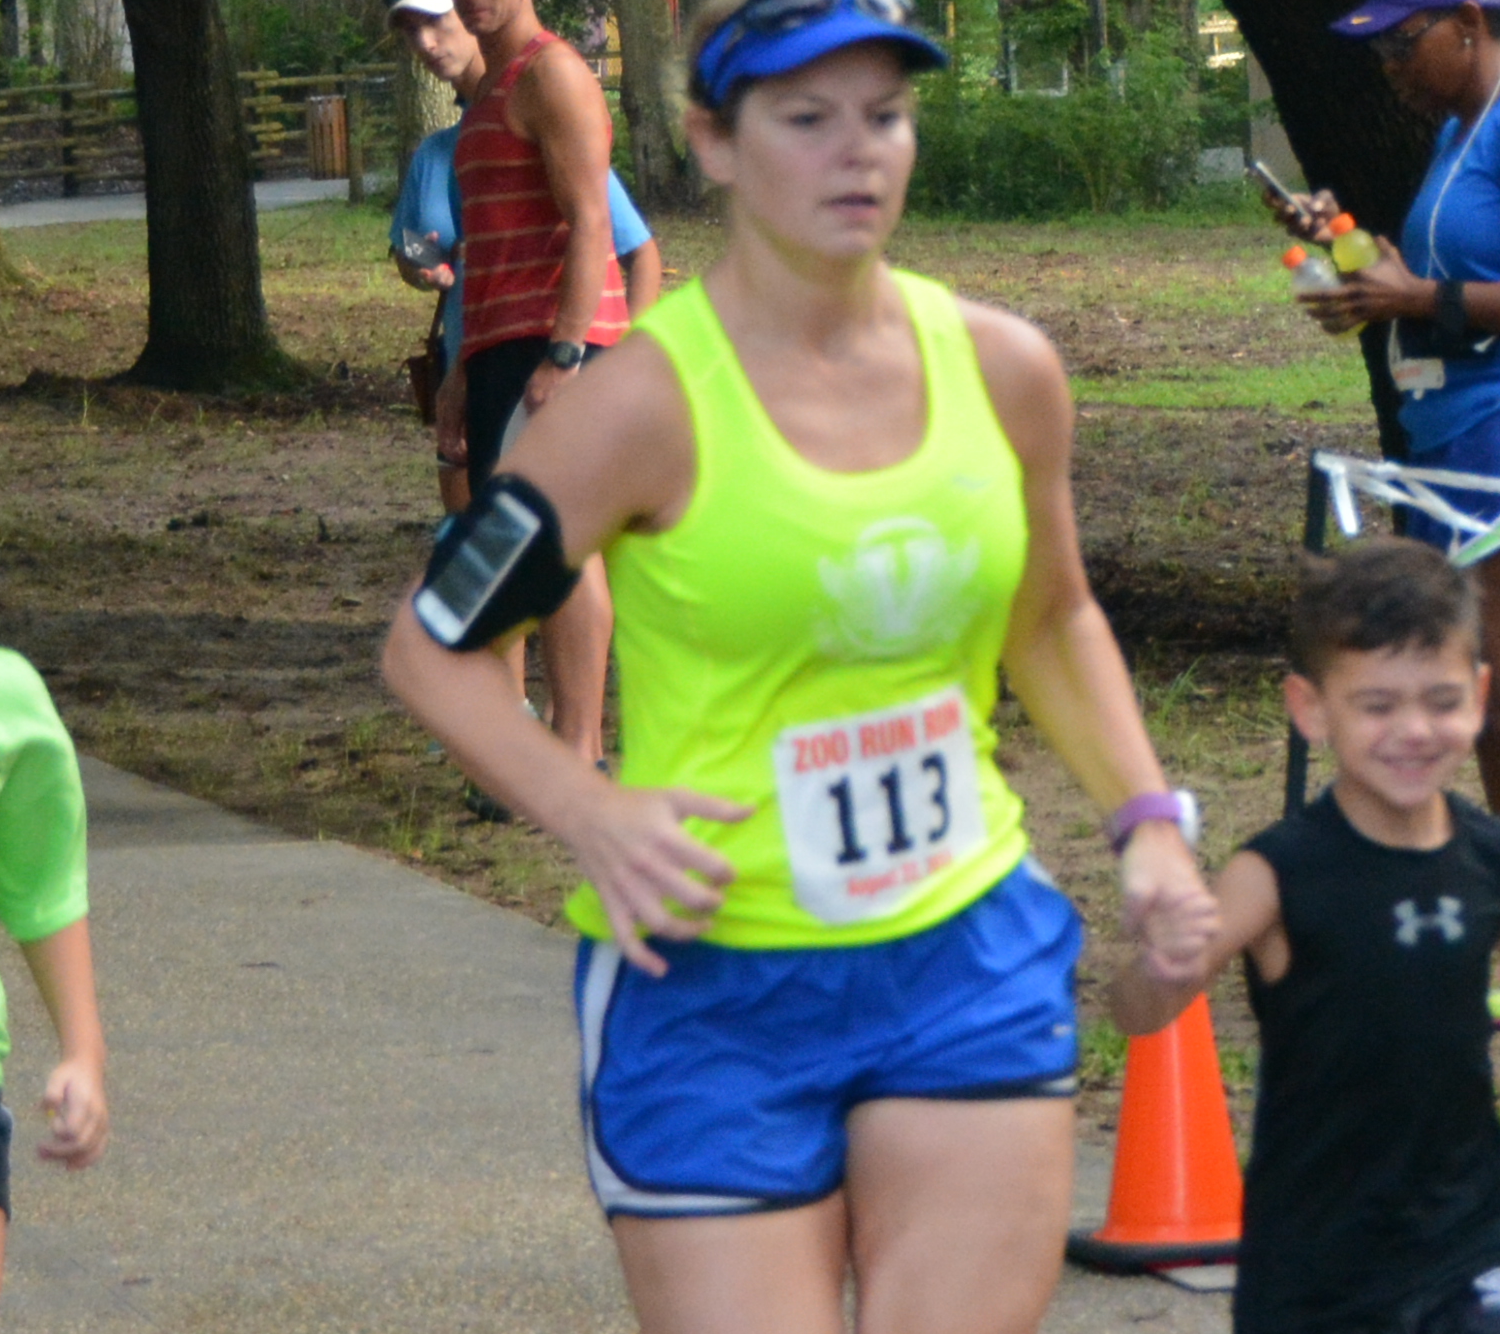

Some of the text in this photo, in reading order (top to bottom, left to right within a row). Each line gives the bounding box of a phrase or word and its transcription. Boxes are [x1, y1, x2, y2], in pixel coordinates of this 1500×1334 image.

[793, 729, 849, 772] ZOO
[859, 715, 916, 758] RUN
[828, 753, 952, 865] 113
